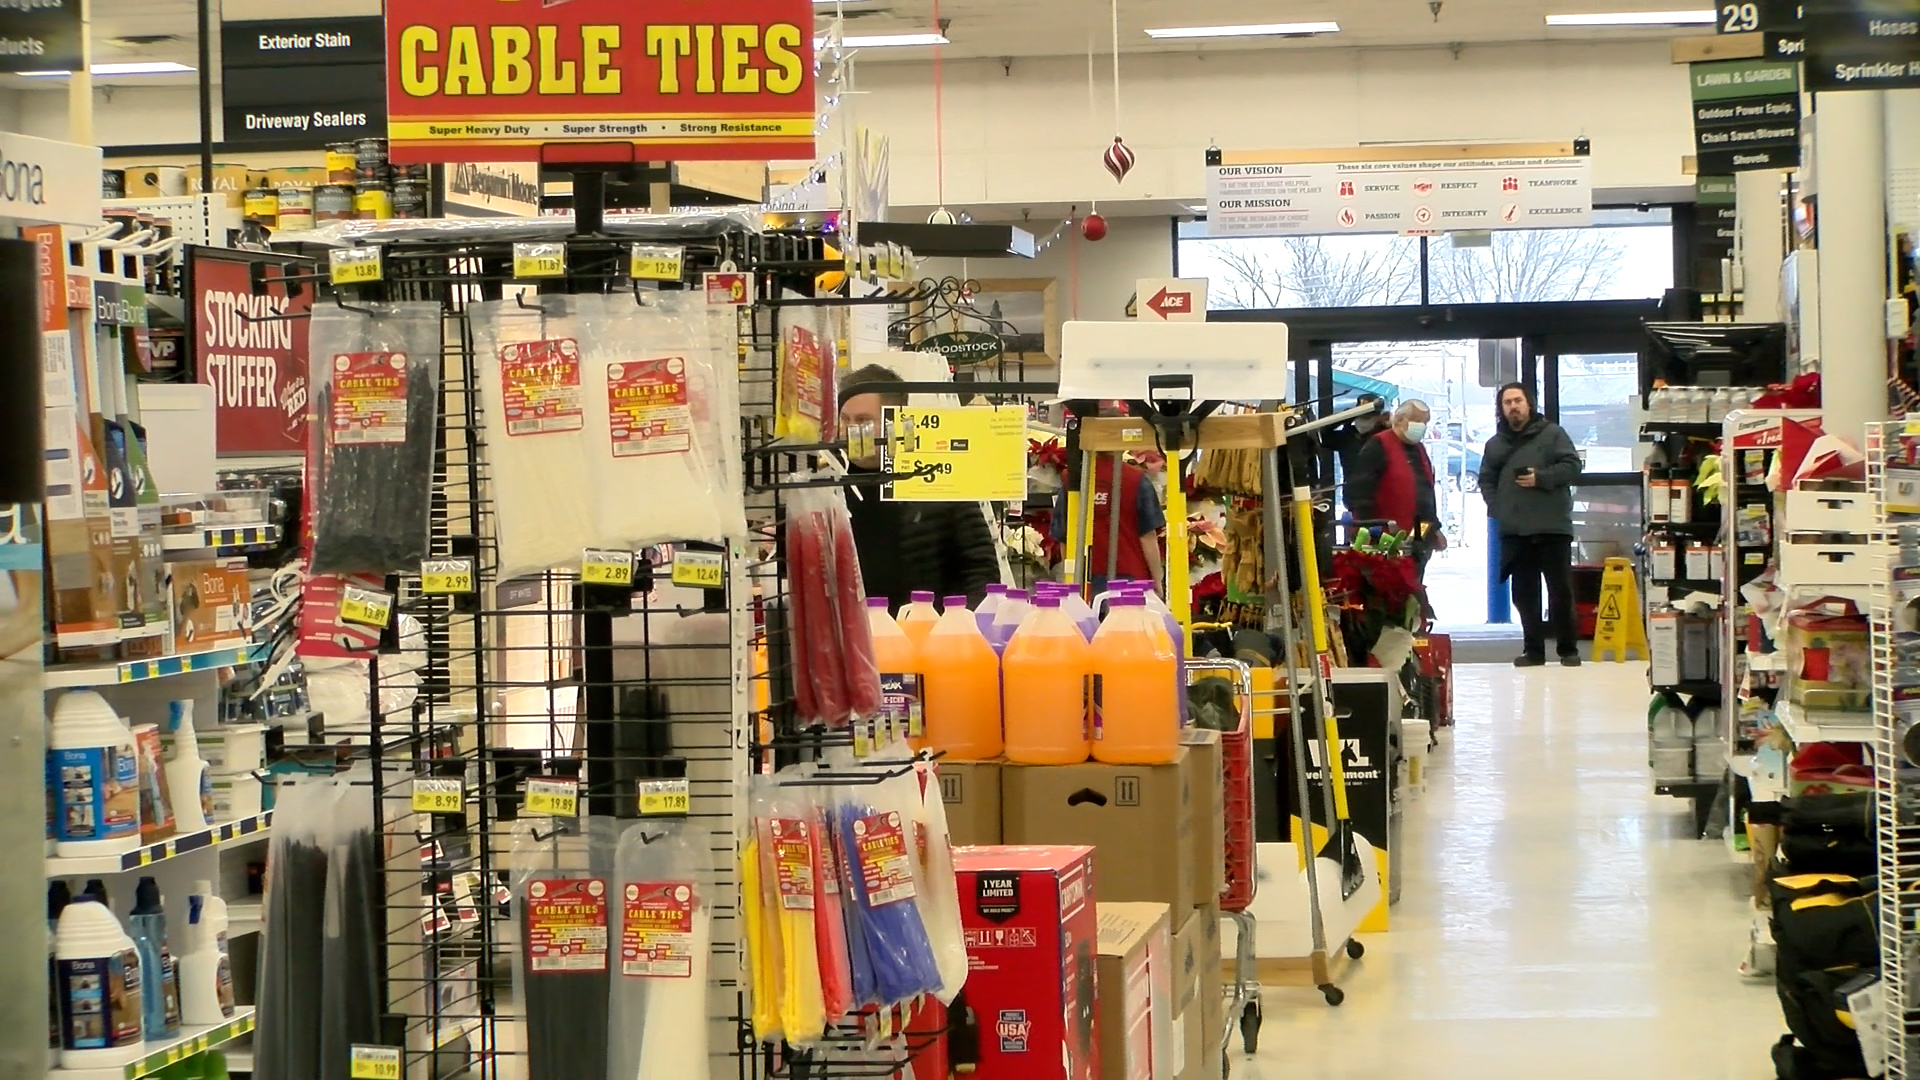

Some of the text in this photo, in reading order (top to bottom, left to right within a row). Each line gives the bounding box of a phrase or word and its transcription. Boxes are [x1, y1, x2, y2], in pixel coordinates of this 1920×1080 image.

[1722, 4, 1759, 32] 29
[1869, 20, 1918, 36] Hoses
[259, 33, 351, 50] Exterior Stain
[400, 23, 803, 97] CABLE TIES
[1697, 68, 1792, 87] LAWN & GARDEN
[1835, 62, 1906, 81] Sprinkler
[1736, 106, 1765, 116] Power
[246, 112, 366, 131] Driveway Sealers
[680, 121, 782, 134] Strong Resistance
[429, 124, 531, 137] Super Heavy Duty
[563, 123, 648, 136] Super Strength
[0, 147, 46, 205] ona
[1219, 166, 1283, 176] OUR VISION
[1364, 184, 1401, 192] SERVICE
[1528, 179, 1579, 187] TEAMWORK
[1219, 199, 1291, 209] OUR MISSION
[1365, 212, 1401, 220] PASSION
[1442, 210, 1488, 218] INTEGRITY
[1529, 207, 1583, 215] EXCELLENCE
[37, 232, 53, 276] Bona
[354, 264, 378, 278] 13.89
[538, 258, 561, 271] 11.89
[655, 262, 678, 276] 12.99
[1160, 296, 1184, 307] ACE
[205, 289, 292, 350] STOCKING
[508, 364, 572, 379] CABLE TIES
[206, 353, 277, 408] STUFFER
[340, 377, 400, 389] CABLE TIES
[614, 383, 679, 398] CABLE TIES
[605, 567, 629, 580] 2.89
[697, 568, 719, 581] 12.49
[203, 573, 225, 594] Bona
[445, 576, 469, 589] 2.99
[363, 606, 386, 622] 13.89
[64, 751, 87, 761] Bona
[435, 795, 459, 807] 8.99
[550, 798, 573, 810] 19.89
[663, 797, 686, 808] 17.89
[983, 879, 1012, 889] 1 YEAR
[982, 888, 1014, 897] LIMITED
[536, 904, 599, 915] CABLE TIES
[628, 909, 684, 919] CABLE TIES
[72, 962, 96, 970] Bona
[1000, 1023, 1026, 1036] USA
[374, 1063, 397, 1077] 10.99
